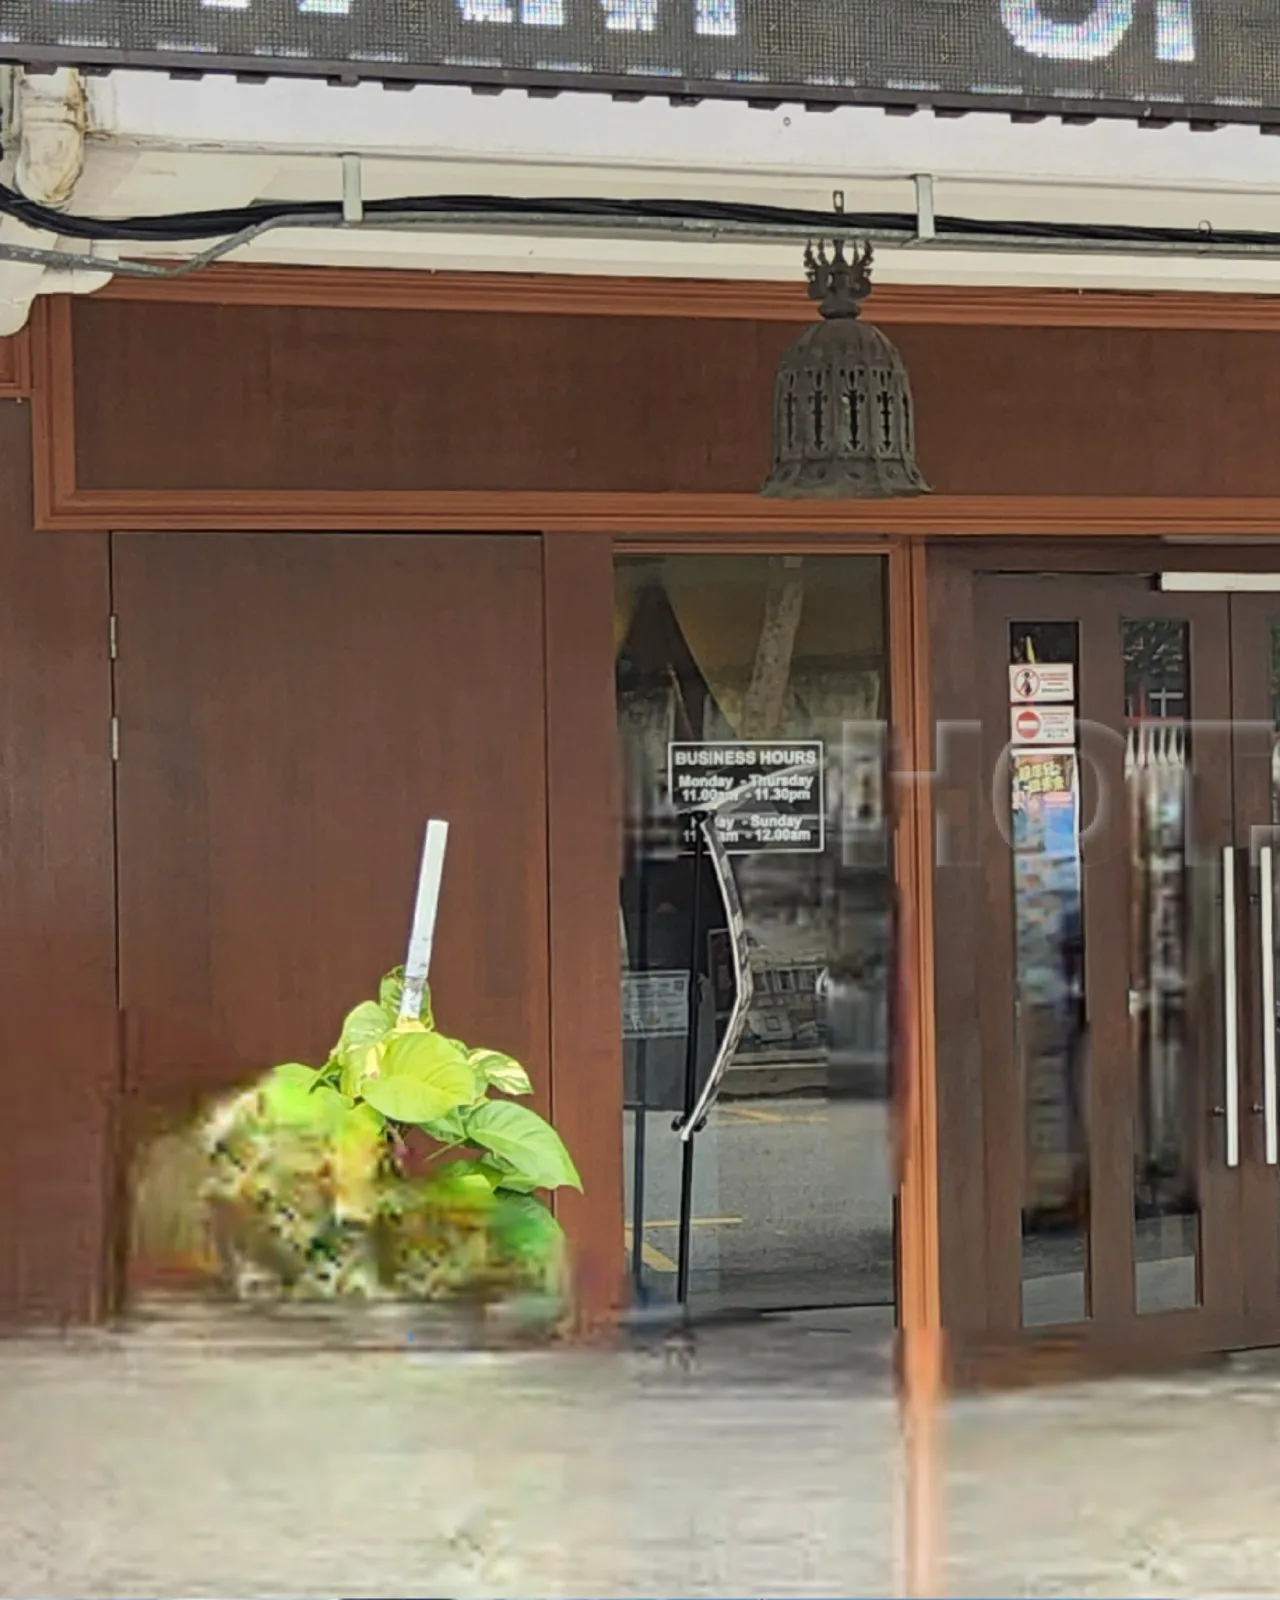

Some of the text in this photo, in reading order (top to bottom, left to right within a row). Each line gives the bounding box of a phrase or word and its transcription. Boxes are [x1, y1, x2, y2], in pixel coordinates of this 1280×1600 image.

[675, 750, 816, 766] BUSINESS HOURS
[678, 774, 734, 790] Monday
[748, 774, 814, 790] Thursday
[754, 788, 811, 804] 11.30pm
[750, 814, 804, 830] Sunday
[754, 829, 811, 842] 12.00am
